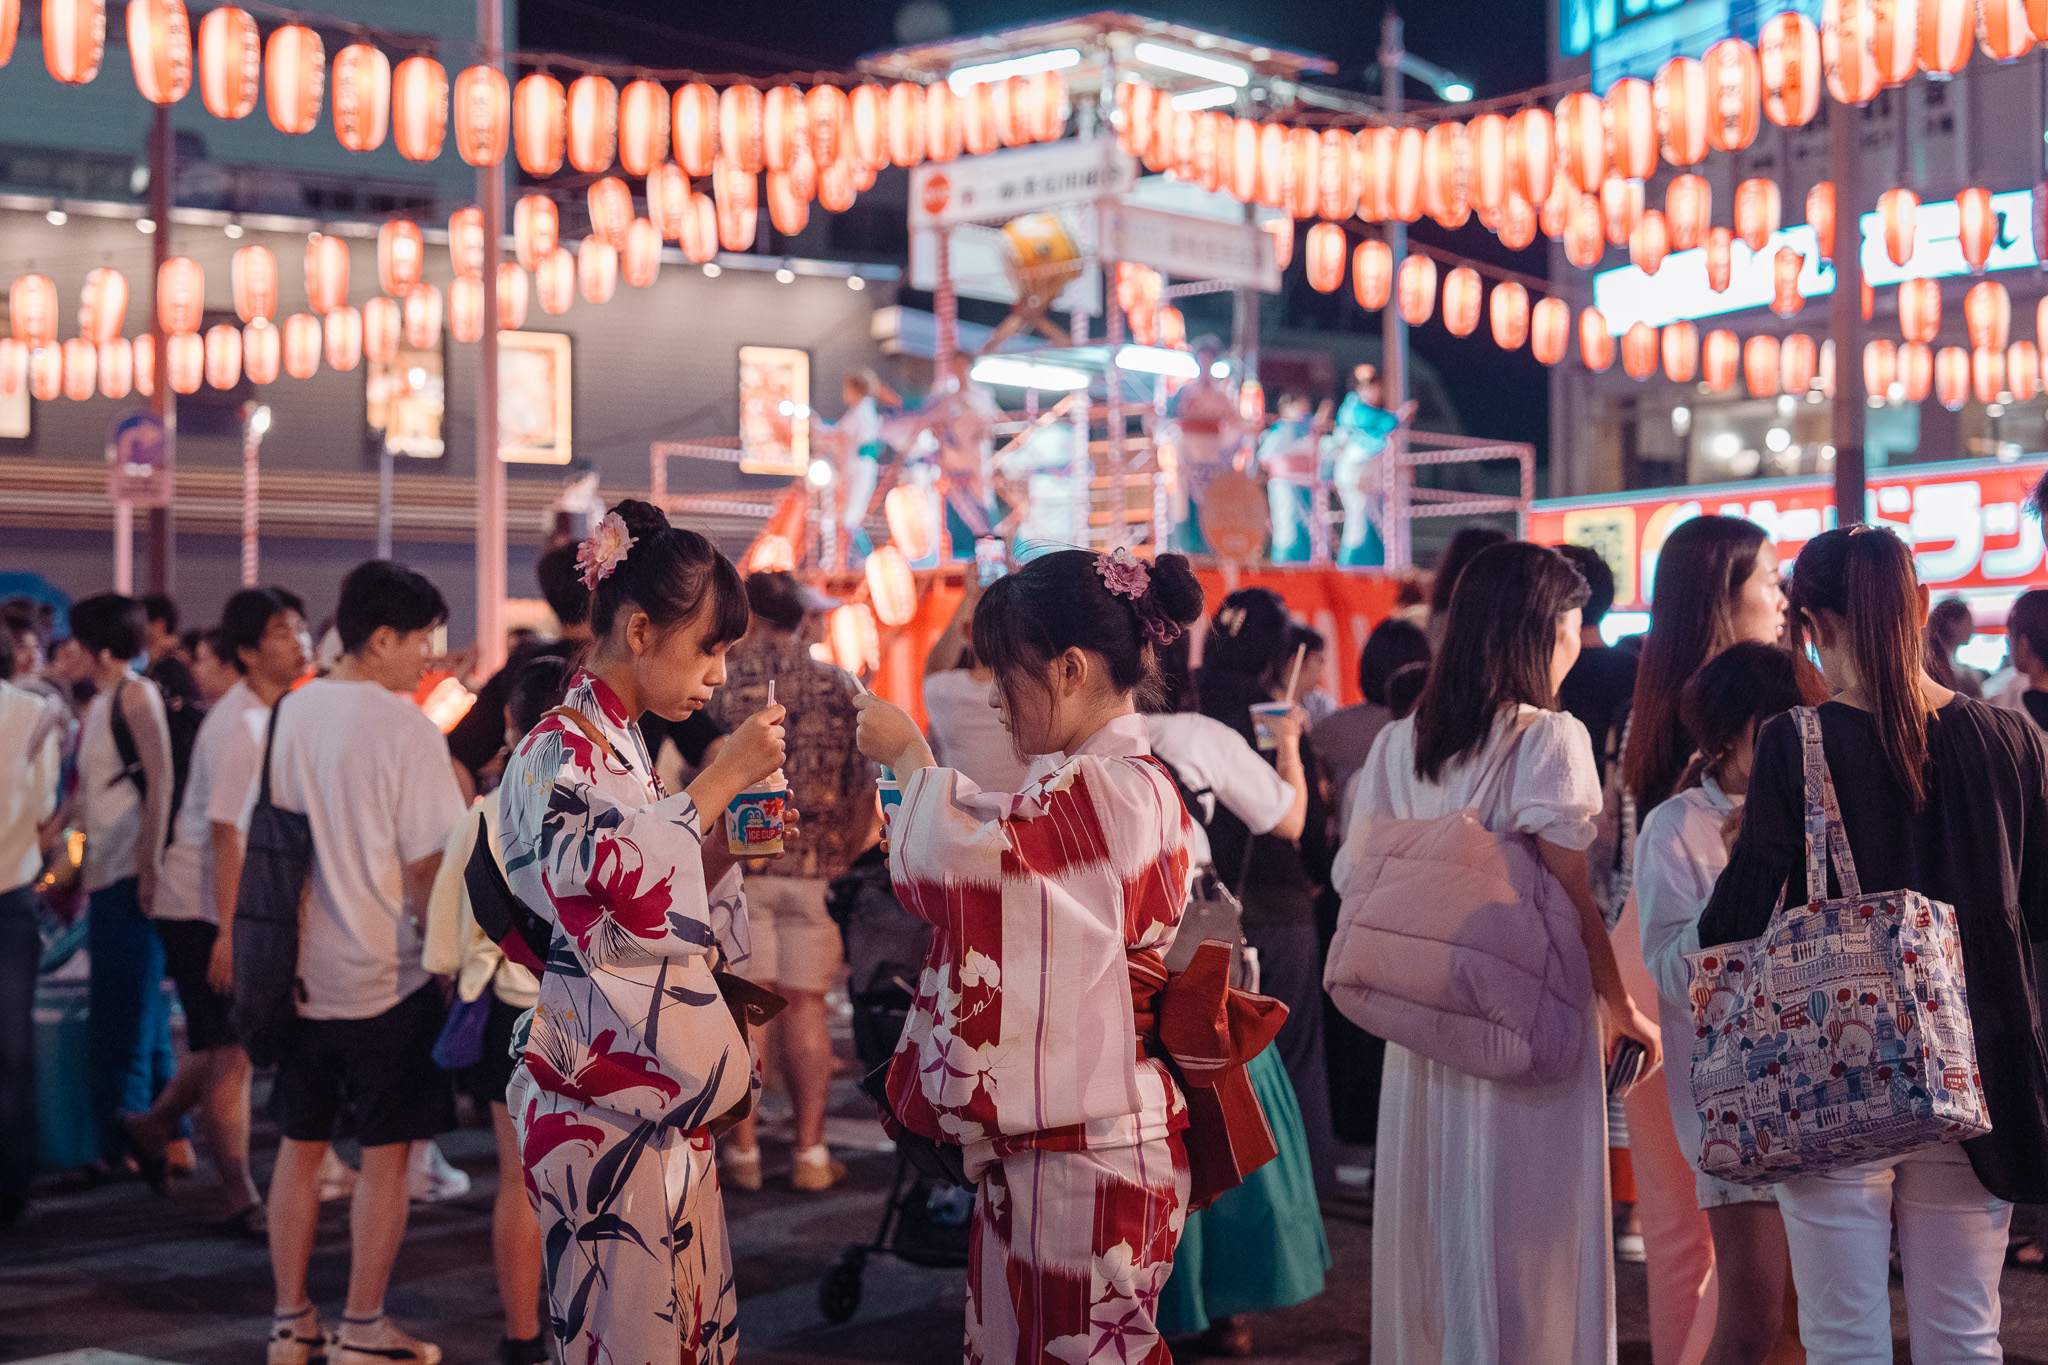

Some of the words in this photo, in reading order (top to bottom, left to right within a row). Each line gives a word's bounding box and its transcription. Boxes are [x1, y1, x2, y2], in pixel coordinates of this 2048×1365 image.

[763, 796, 784, 817] 氷
[749, 830, 760, 839] ICE
[762, 830, 775, 839] CUP
[1844, 935, 1870, 946] Harrods
[1841, 1046, 1866, 1061] Harrods
[1749, 1095, 1780, 1113] Harrods
[1867, 1098, 1889, 1112] Harrods
